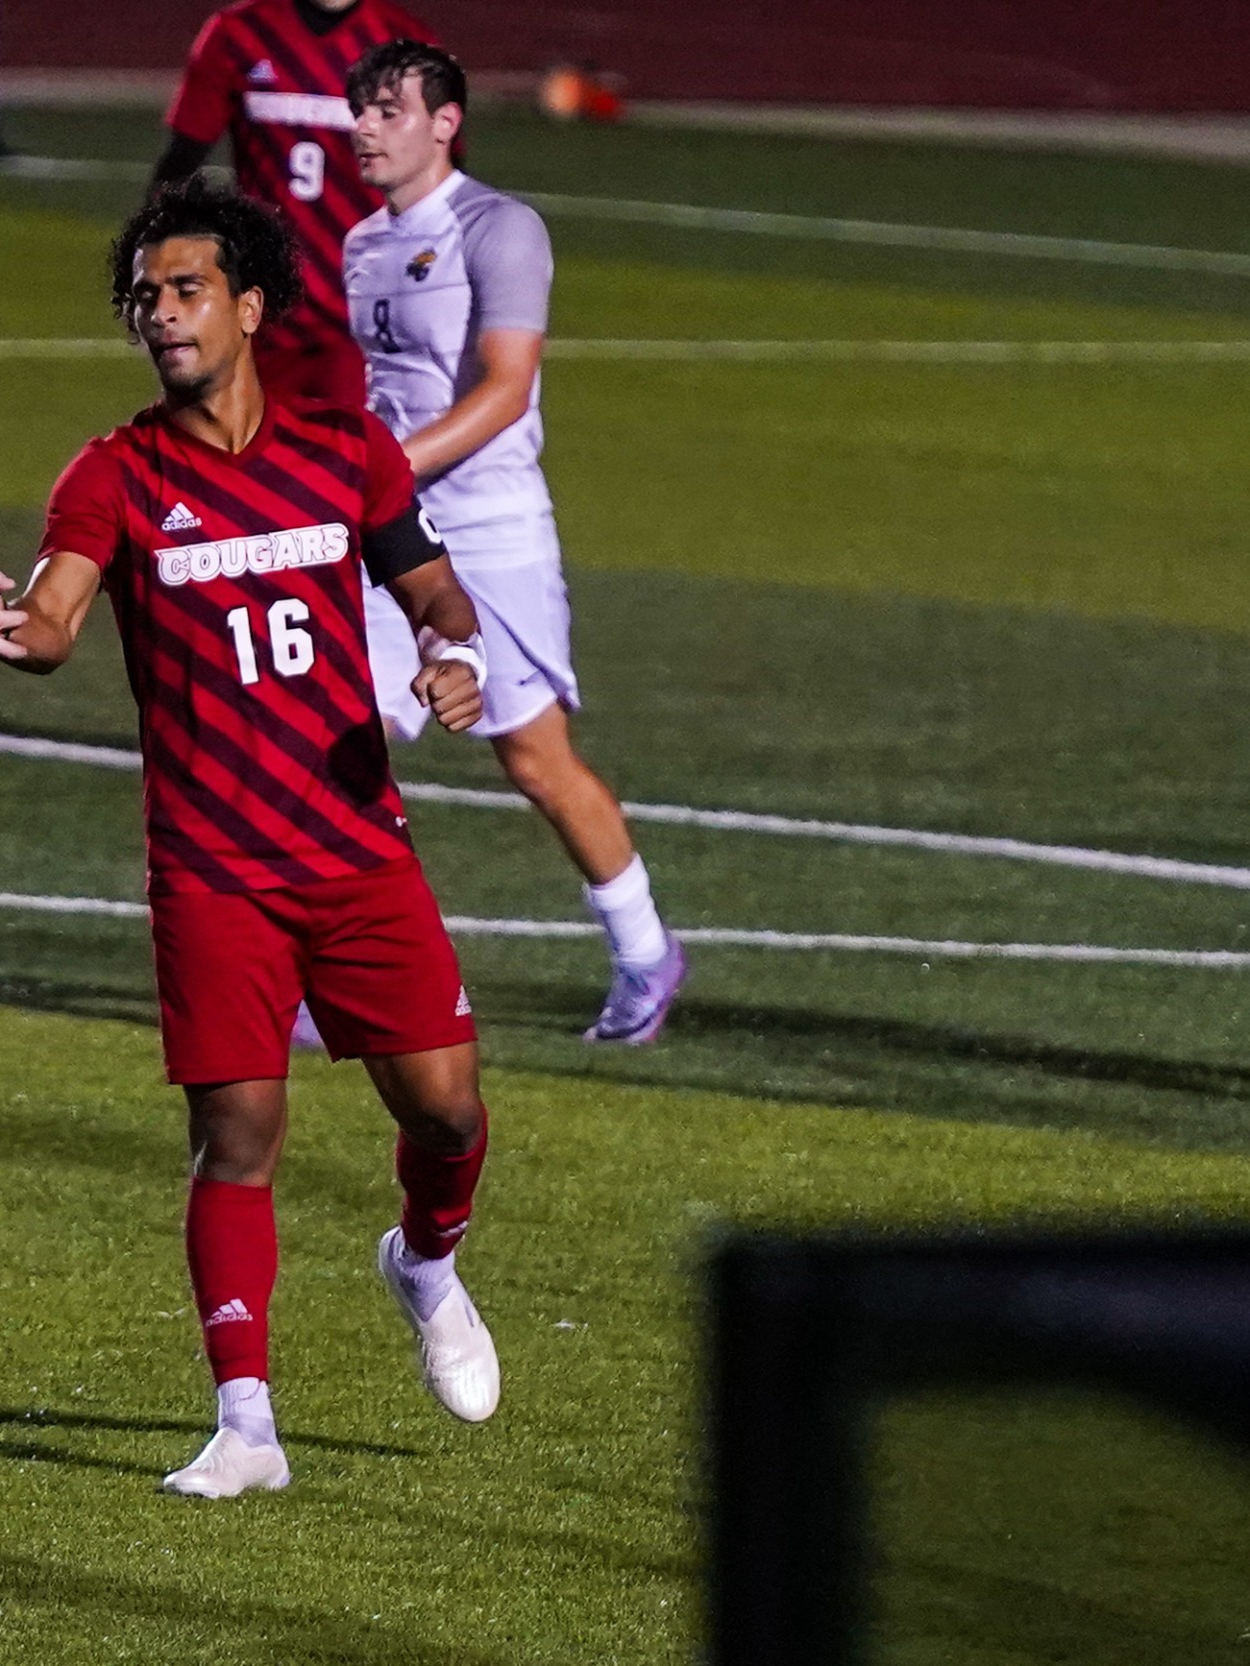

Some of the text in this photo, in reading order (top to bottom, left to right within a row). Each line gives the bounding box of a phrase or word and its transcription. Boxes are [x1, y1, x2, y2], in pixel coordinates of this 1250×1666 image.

[289, 141, 325, 201] 9
[154, 522, 349, 586] COUGARS
[161, 517, 202, 531] adidas
[227, 598, 315, 685] 16
